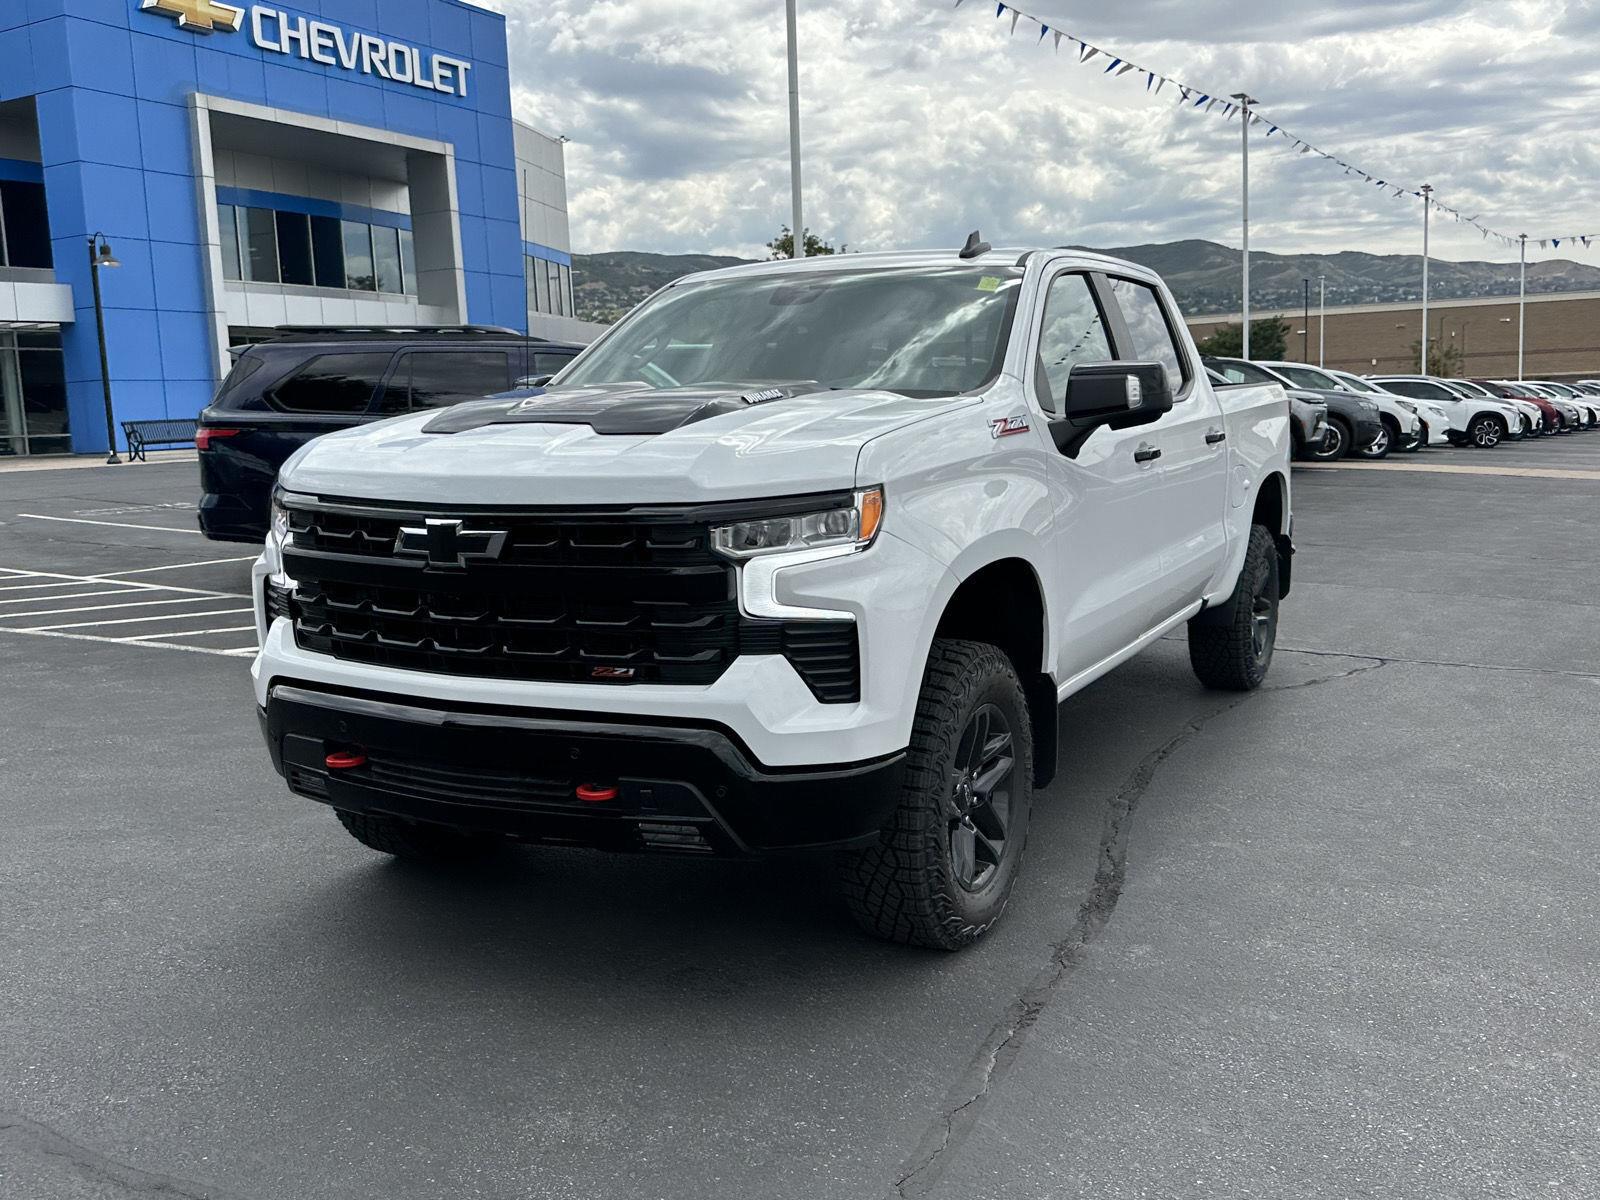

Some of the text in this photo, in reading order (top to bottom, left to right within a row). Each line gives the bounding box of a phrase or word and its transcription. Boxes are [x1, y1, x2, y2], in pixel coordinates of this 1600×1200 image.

[251, 4, 471, 97] CHEVROLET
[742, 388, 784, 404] DURAMAX
[987, 414, 1031, 439] Z71
[591, 666, 636, 678] Z71
